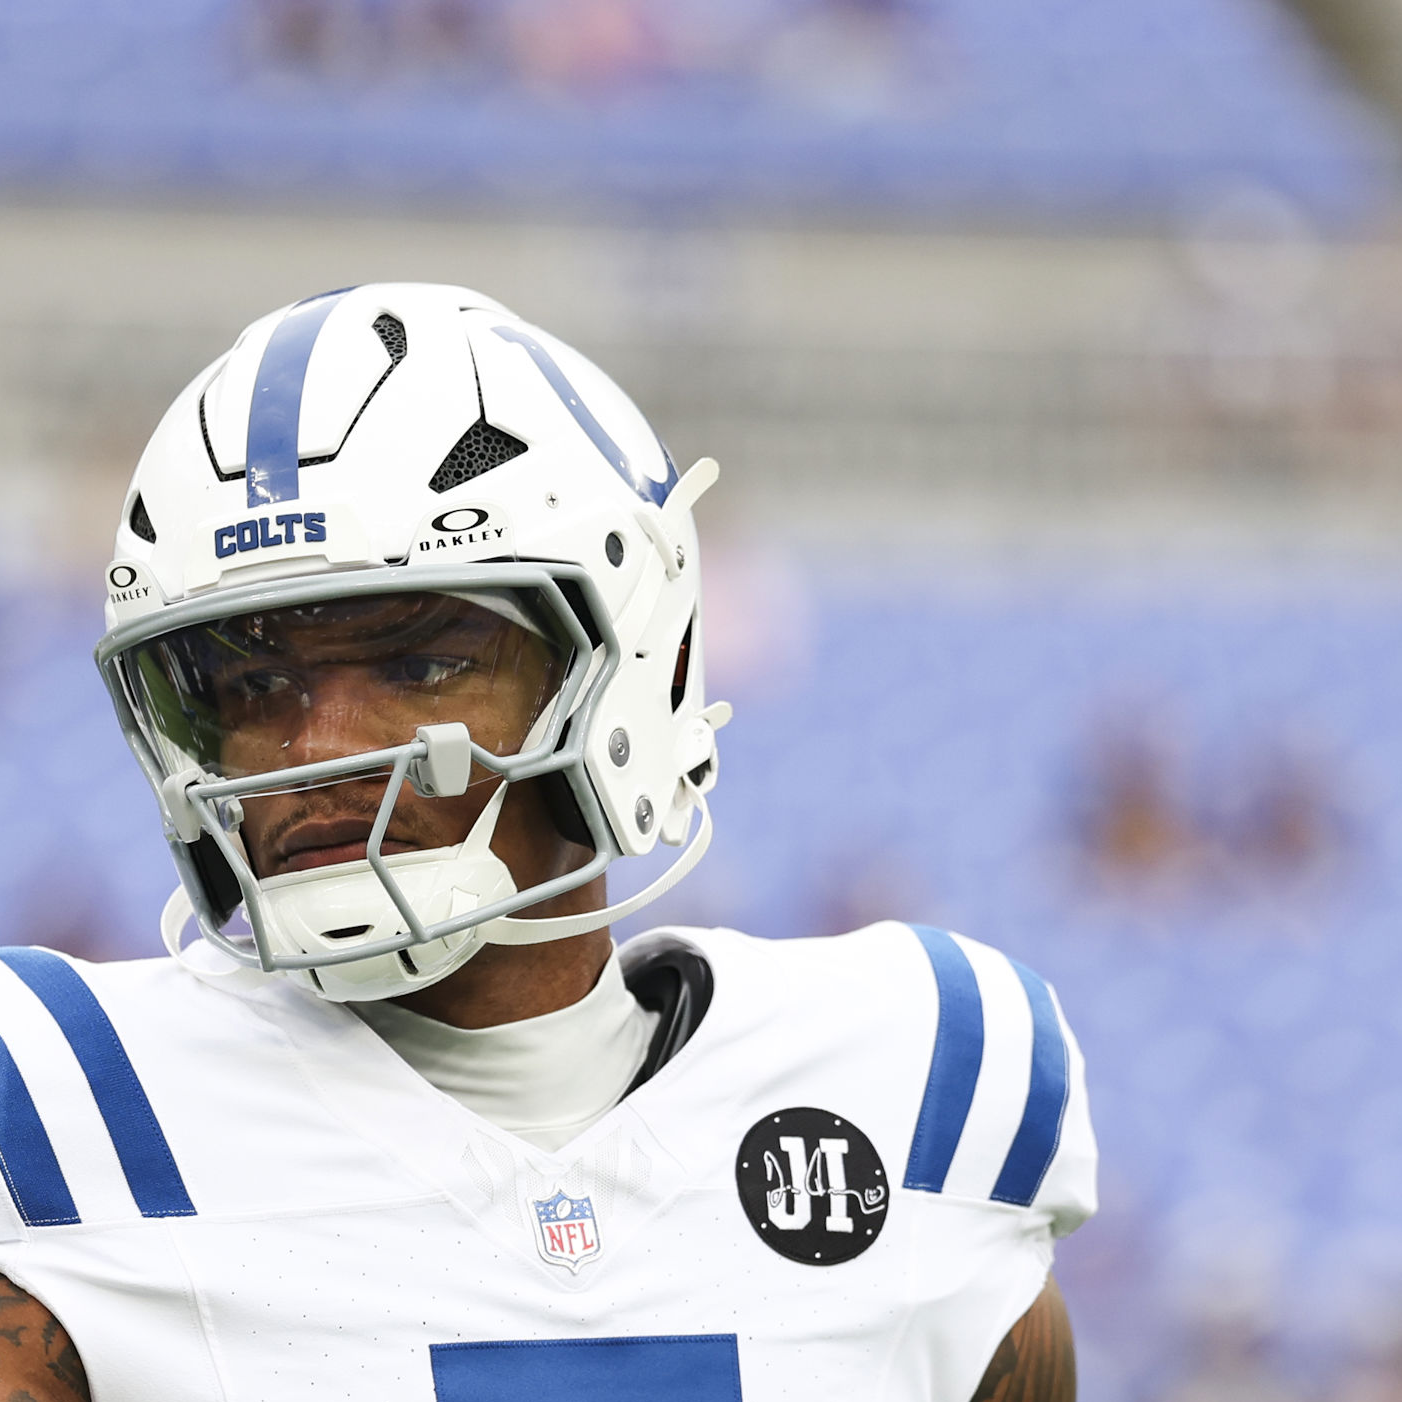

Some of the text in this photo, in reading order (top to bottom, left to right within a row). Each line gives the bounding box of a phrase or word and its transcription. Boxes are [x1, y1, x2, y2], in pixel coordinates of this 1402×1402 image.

[214, 511, 327, 559] COLTS
[419, 527, 505, 551] OAKLEY
[110, 586, 150, 604] OAKLEY
[546, 1222, 594, 1255] NFL
